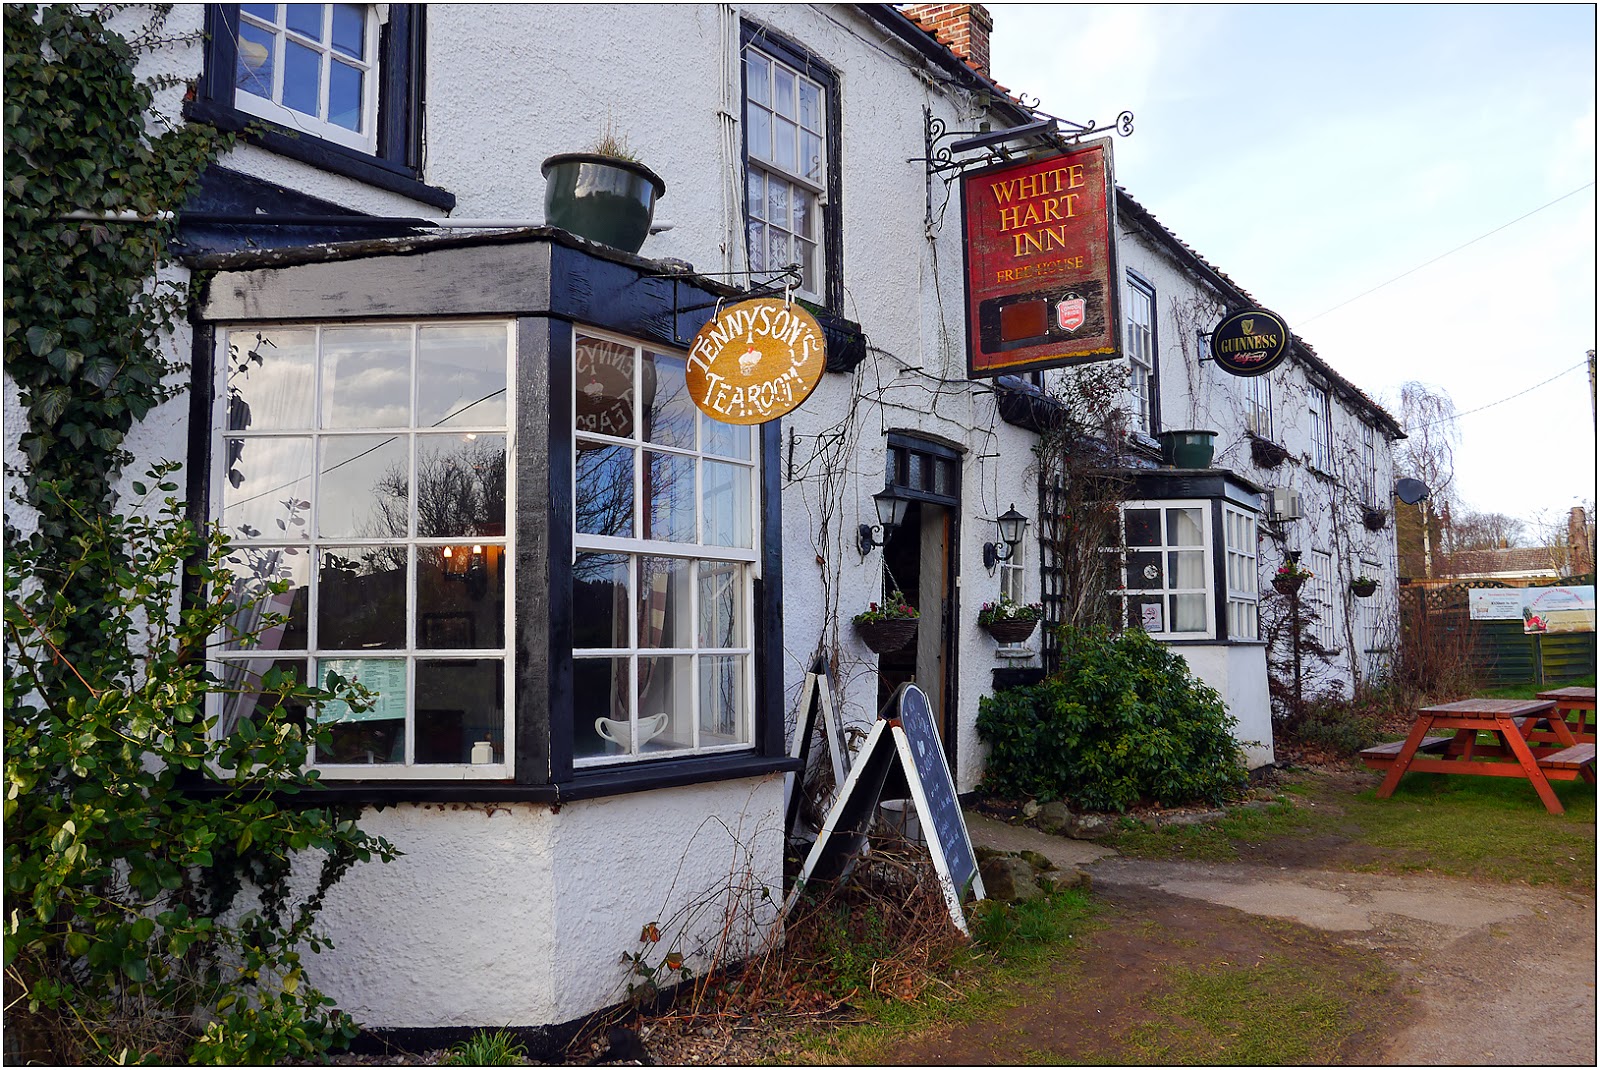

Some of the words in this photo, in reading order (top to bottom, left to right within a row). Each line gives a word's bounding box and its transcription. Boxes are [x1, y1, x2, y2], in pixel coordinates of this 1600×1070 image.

[990, 163, 1085, 204] WHITE
[999, 193, 1079, 232] HART
[1013, 224, 1067, 258] INN
[997, 264, 1033, 283] FREE
[1037, 255, 1084, 276] HOUSE
[687, 304, 819, 373] TENNYSON'S
[1221, 334, 1277, 353] GUINNESS
[703, 366, 808, 417] TEAROOM
